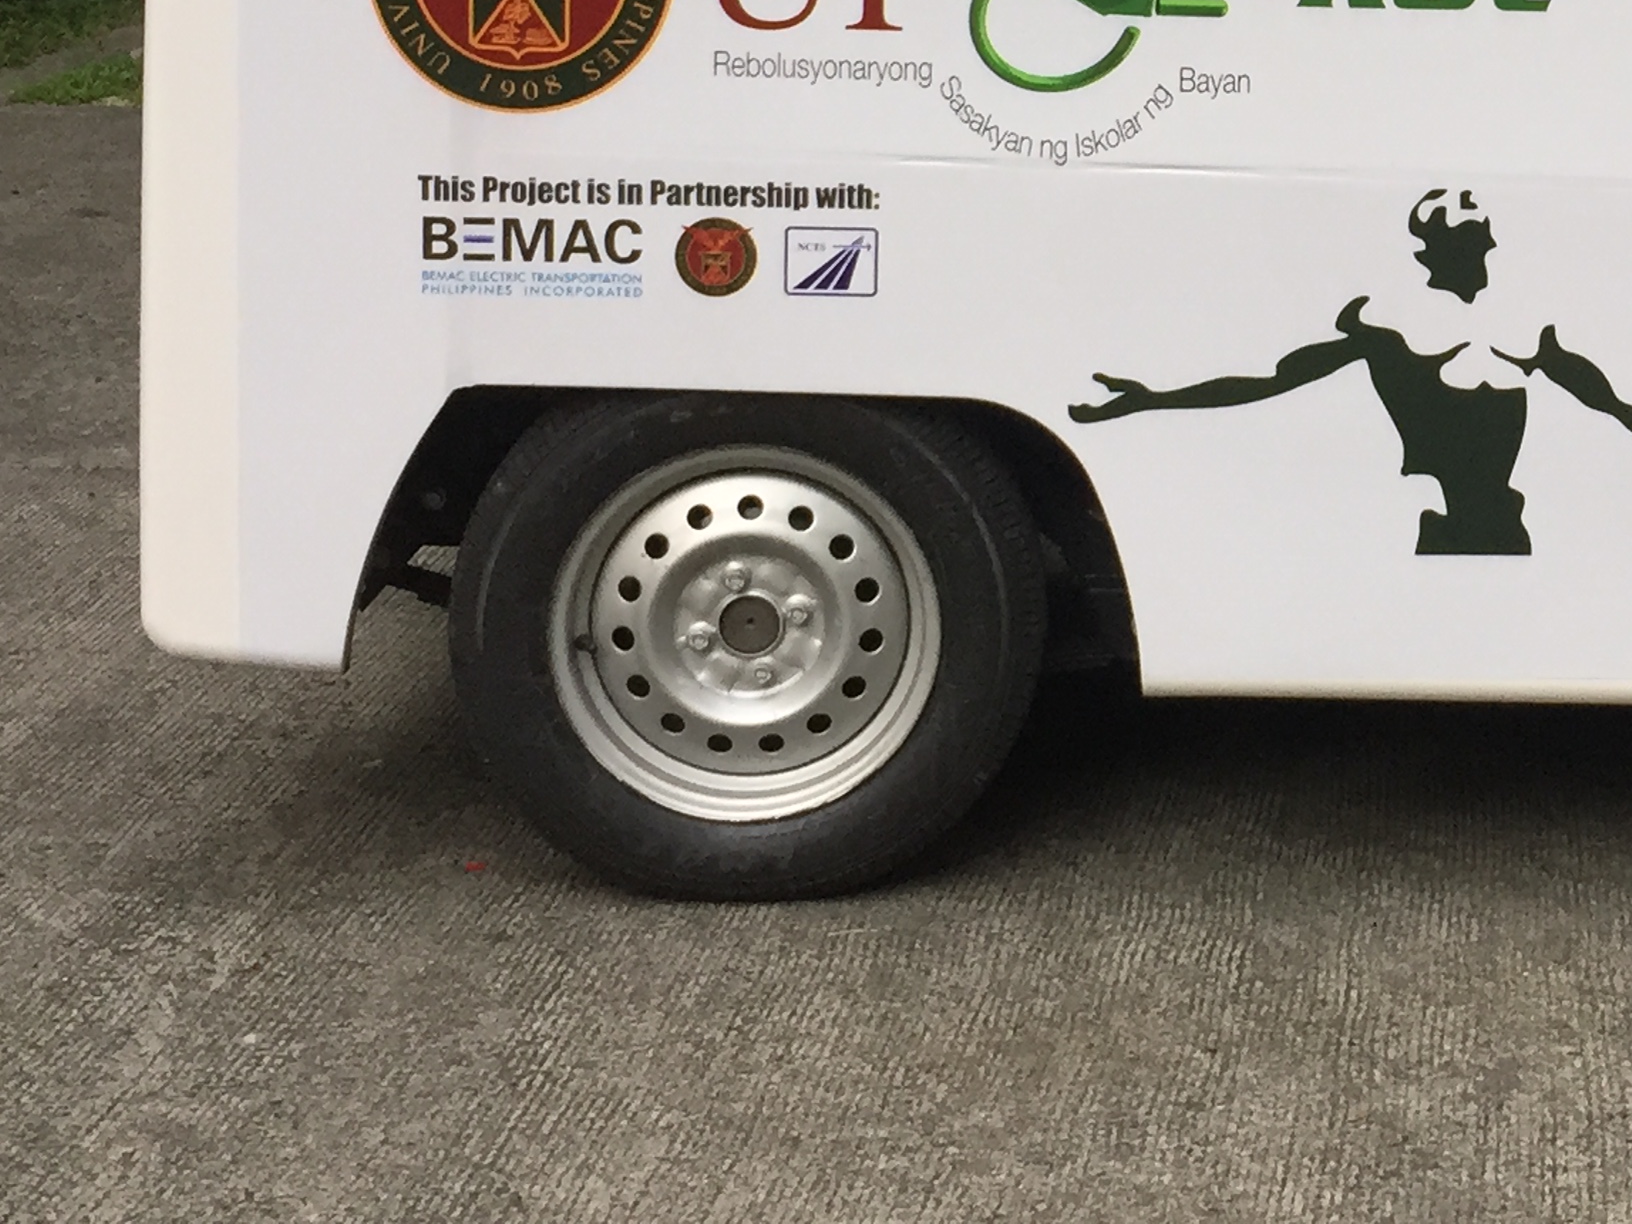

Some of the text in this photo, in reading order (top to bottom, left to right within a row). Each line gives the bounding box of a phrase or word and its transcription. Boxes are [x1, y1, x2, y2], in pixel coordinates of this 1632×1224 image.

[479, 73, 563, 101] 1908
[713, 51, 1252, 166] Rebolusyonaryong Sasakyan ng Iskolar ng Bayan
[417, 174, 881, 211] This Project is in Partnership with:
[421, 216, 643, 264] BEMAC
[421, 270, 643, 284] BEMAC ELECTRIC TRANSPORTATION
[421, 284, 643, 298] PHILIPPINES INCORPORATED
